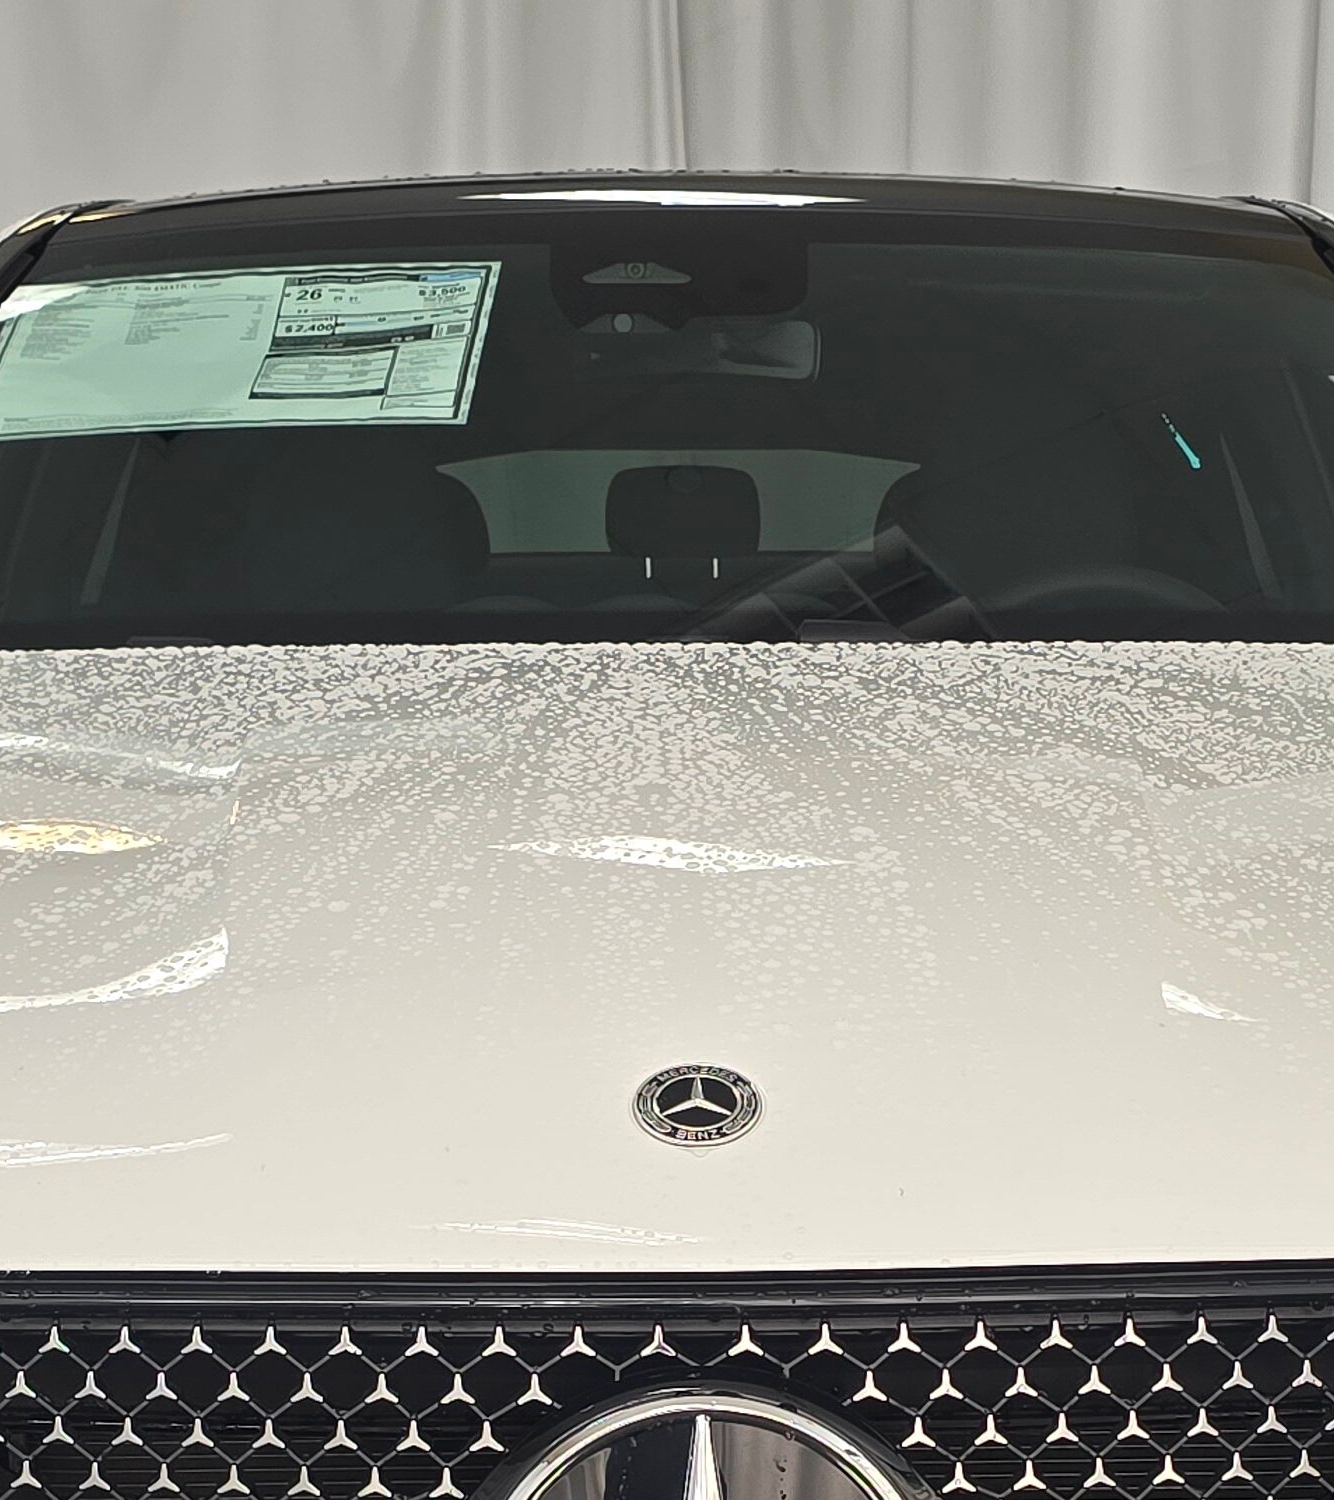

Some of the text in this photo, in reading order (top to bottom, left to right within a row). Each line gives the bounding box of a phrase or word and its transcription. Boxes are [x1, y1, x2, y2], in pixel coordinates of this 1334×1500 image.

[295, 288, 323, 302] 26
[656, 1065, 738, 1083] MERCEDES
[675, 1128, 721, 1141] BENZ
